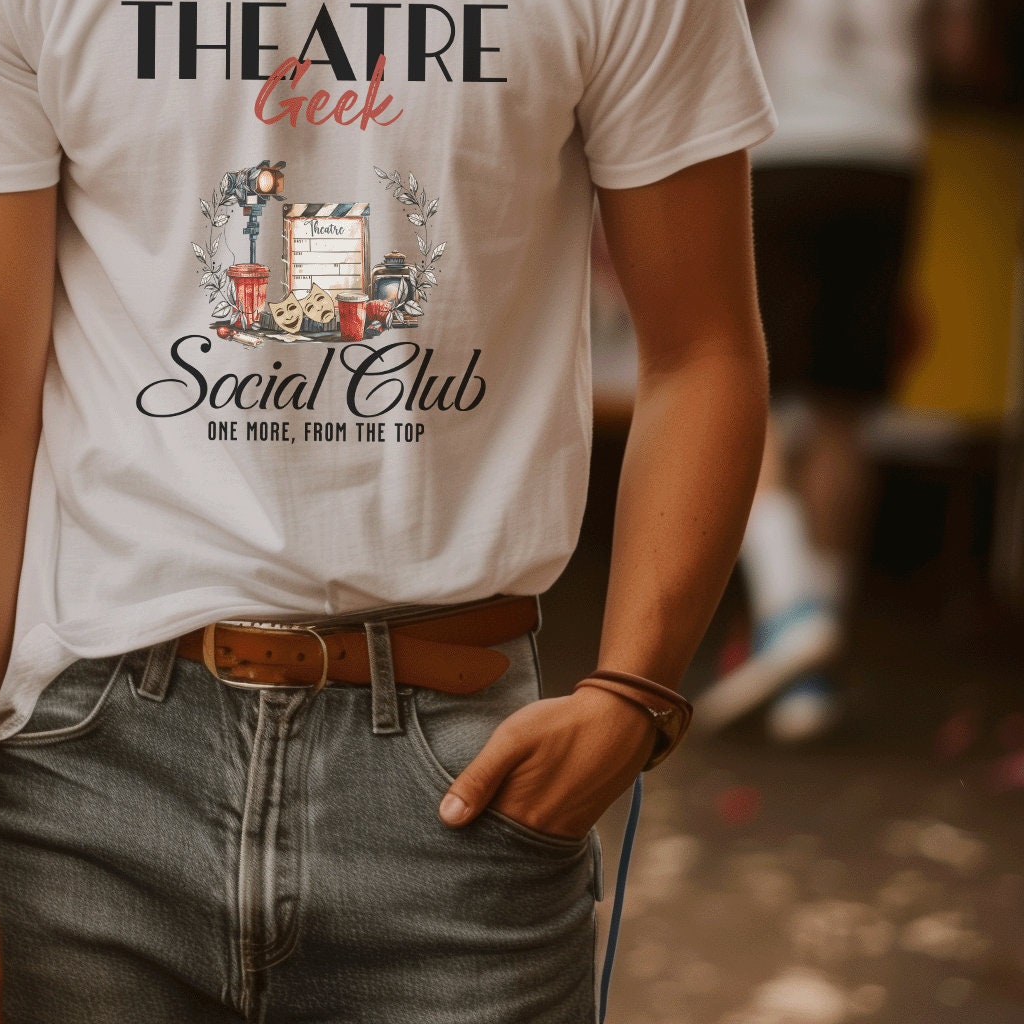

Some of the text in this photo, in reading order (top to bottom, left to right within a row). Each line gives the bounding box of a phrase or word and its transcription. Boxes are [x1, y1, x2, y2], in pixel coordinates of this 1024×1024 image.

[121, 1, 508, 82] THEATRE
[254, 53, 404, 131] Geek
[303, 220, 345, 237] Theatre
[135, 334, 487, 418] Social Club
[208, 421, 425, 444] ONE MORE, FROM THE TOP
